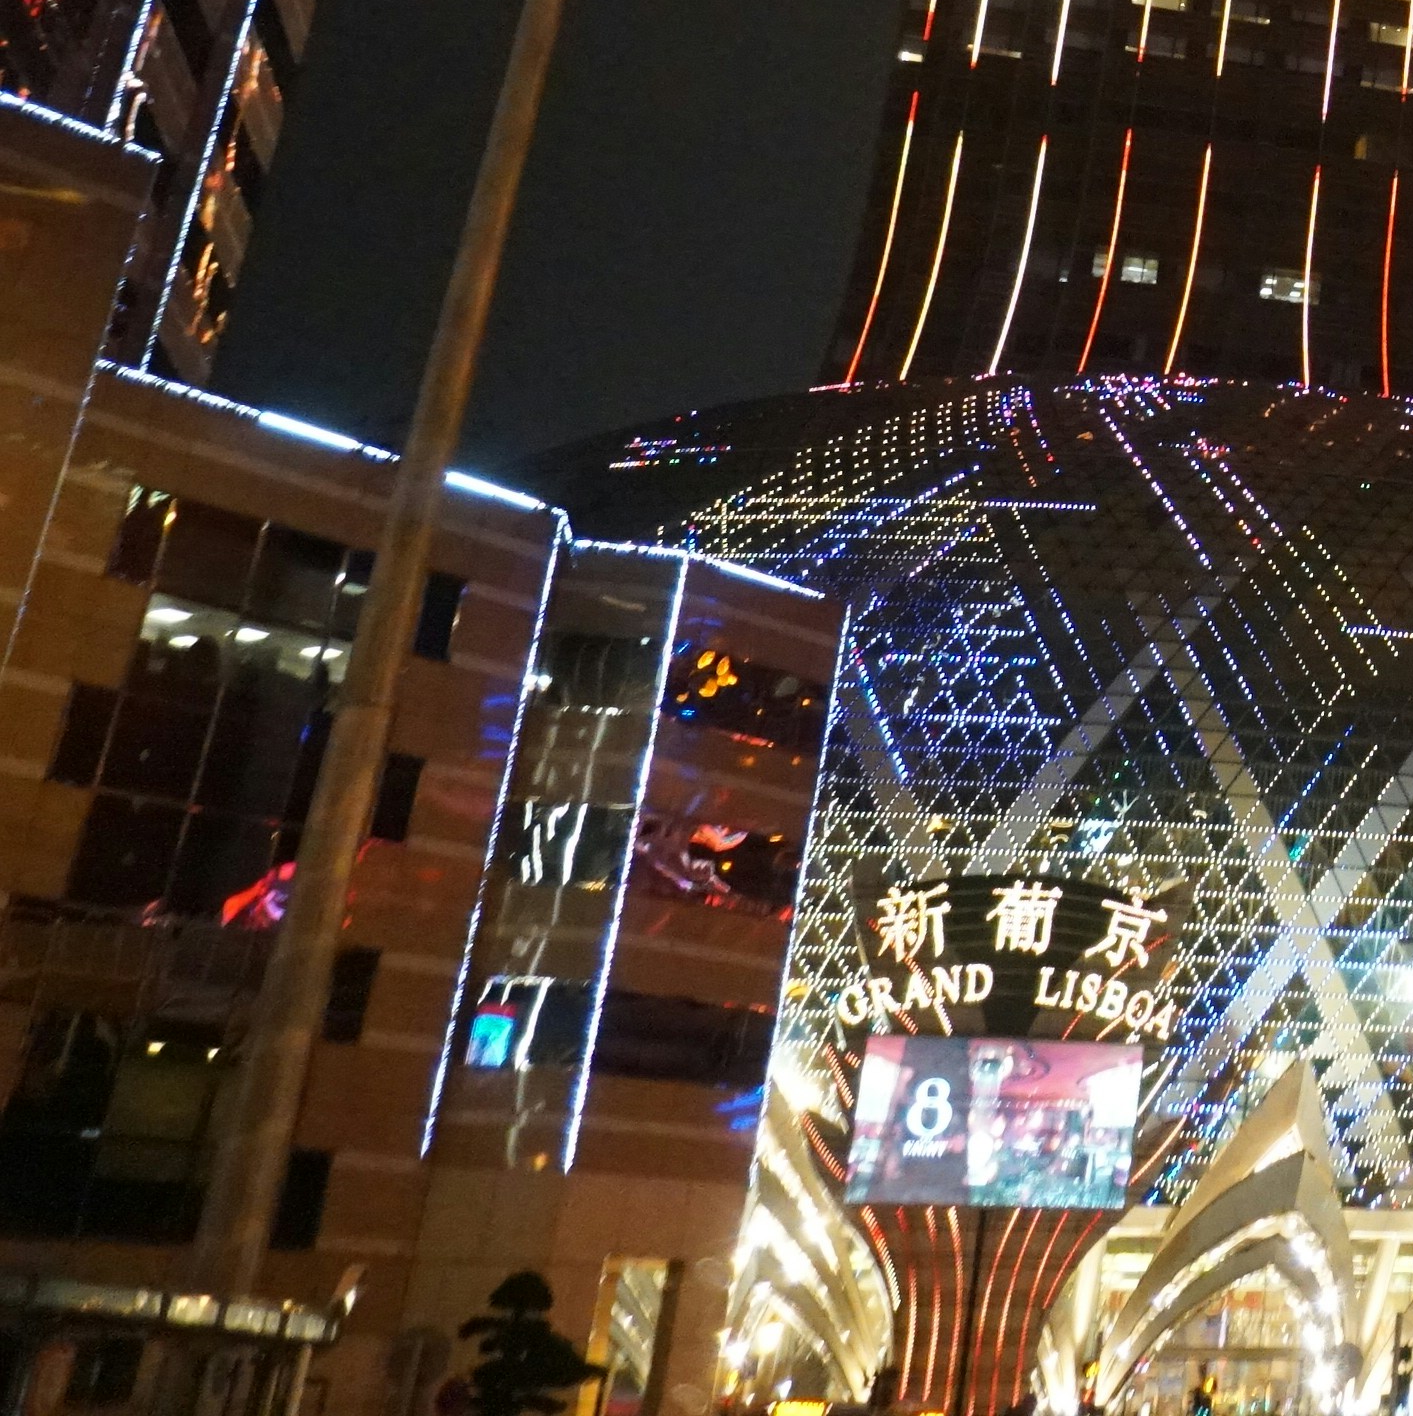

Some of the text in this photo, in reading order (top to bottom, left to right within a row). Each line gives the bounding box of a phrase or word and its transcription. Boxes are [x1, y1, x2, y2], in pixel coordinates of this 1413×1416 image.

[876, 879, 1169, 970] 新葡京
[836, 963, 1176, 1041] GRAND LISBOA
[905, 1076, 954, 1137] 8
